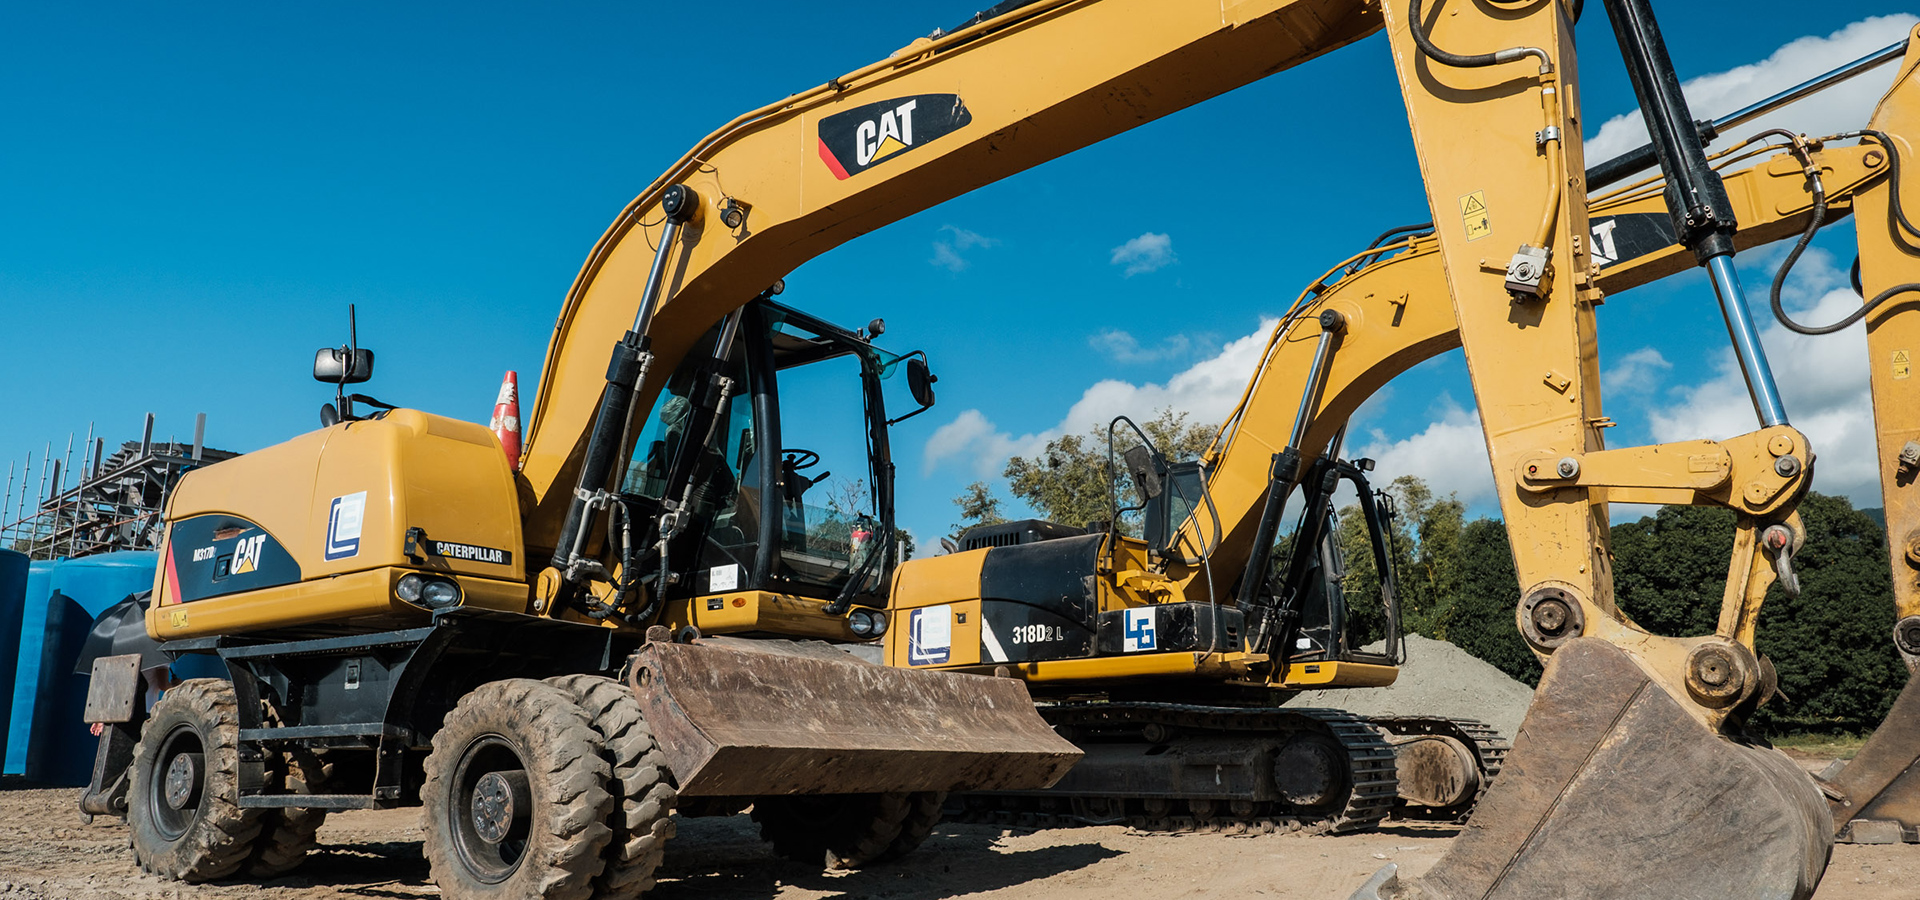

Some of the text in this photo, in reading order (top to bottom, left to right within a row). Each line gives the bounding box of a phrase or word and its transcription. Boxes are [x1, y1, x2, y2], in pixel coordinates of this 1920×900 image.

[856, 99, 916, 166] CAT
[231, 534, 266, 575] CAT
[436, 541, 503, 563] CATERPILLAR
[1056, 626, 1064, 641] L
